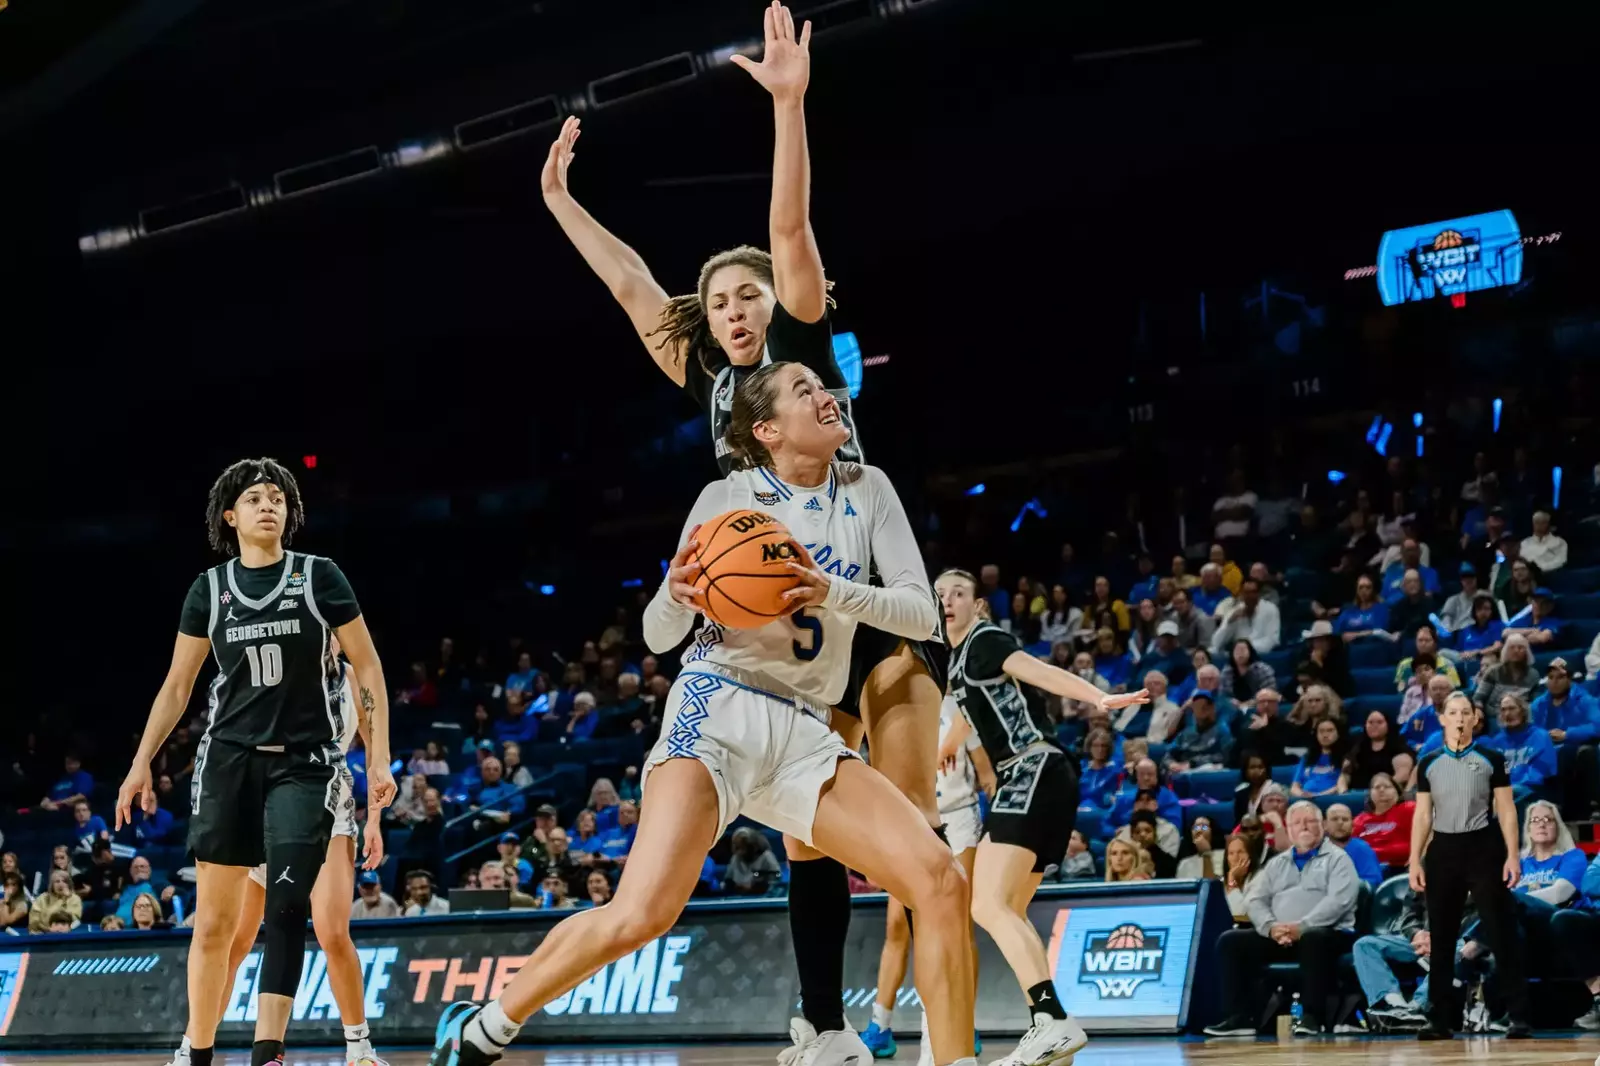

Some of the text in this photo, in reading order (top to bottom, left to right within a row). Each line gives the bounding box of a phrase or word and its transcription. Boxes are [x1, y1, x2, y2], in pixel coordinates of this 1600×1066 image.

[1292, 377, 1320, 396] 114
[226, 619, 301, 643] GEORGETOWN
[792, 606, 823, 662] 5
[245, 643, 283, 687] 10
[1084, 949, 1163, 972] WBIT
